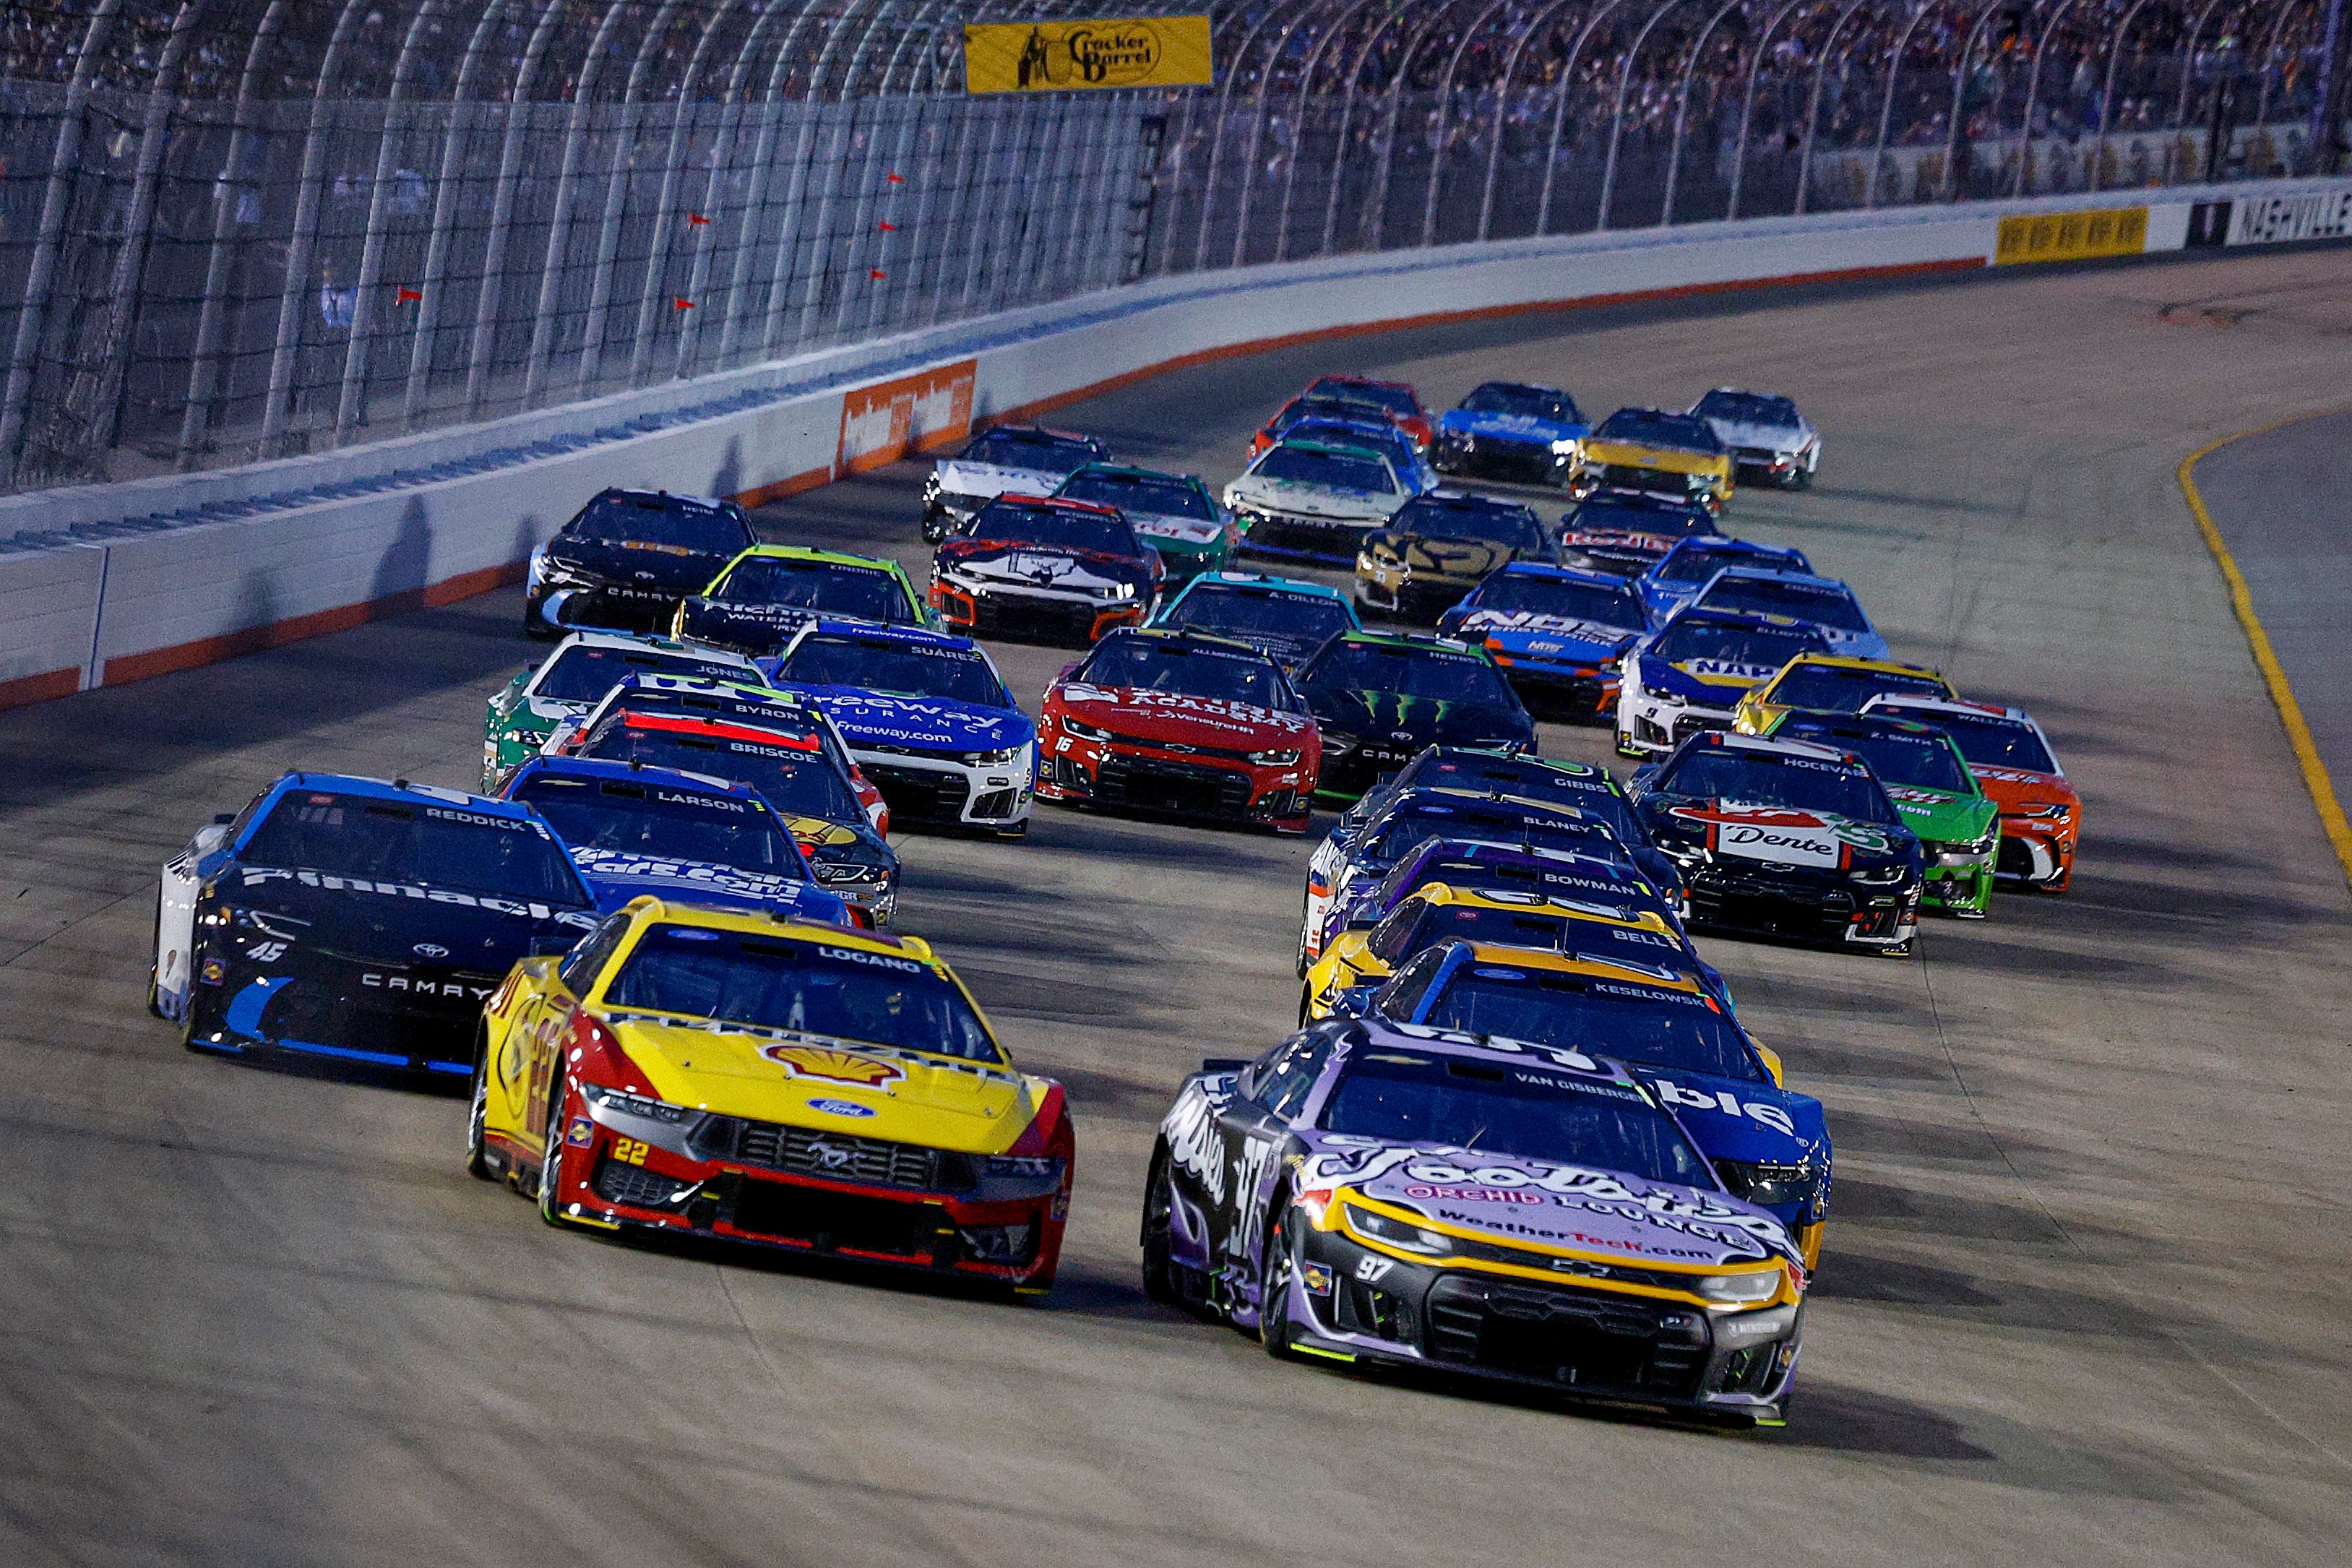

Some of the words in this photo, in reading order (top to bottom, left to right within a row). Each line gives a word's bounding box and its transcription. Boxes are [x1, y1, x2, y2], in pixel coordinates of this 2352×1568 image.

[1069, 31, 1147, 64] Cracker
[1083, 48, 1152, 82] Barrel
[696, 665, 754, 681] JONES
[735, 704, 801, 721] BYRON
[799, 692, 1004, 729] reeway
[730, 742, 818, 764] BRISCOE
[1054, 736, 1074, 752] 16
[1554, 777, 1608, 793] GIBBS
[658, 791, 745, 814] LARSON
[426, 807, 526, 832] REDDICK
[1523, 816, 1590, 833] BLANEY
[1545, 873, 1636, 896] BOWMAN
[1612, 929, 1669, 947] BELL
[246, 941, 288, 962] 46
[818, 947, 921, 973] LOGANO
[361, 973, 494, 1001] CAMRY
[1595, 982, 1710, 1009] KESELOWSK
[1515, 1072, 1554, 1087] VAN
[1647, 1078, 1794, 1137] ble
[613, 1137, 650, 1166] 22
[1439, 1208, 1713, 1259] WeatherTech.com
[1553, 1194, 1754, 1251] LOUNGE
[1356, 1254, 1395, 1283] 97
